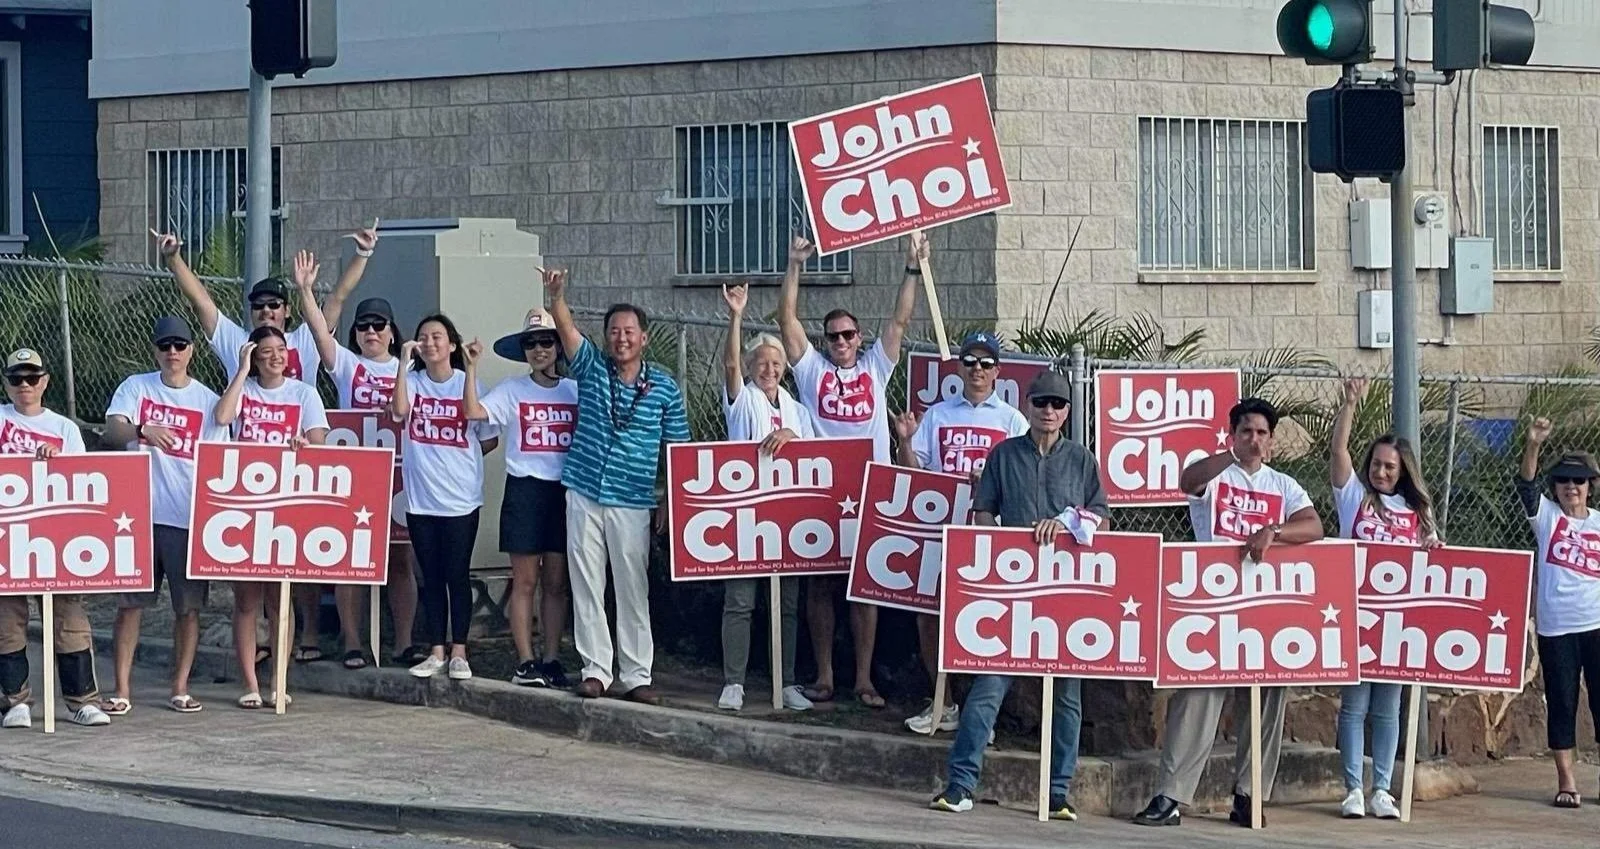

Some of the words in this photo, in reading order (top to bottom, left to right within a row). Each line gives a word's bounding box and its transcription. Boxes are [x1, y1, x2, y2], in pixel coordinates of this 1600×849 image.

[811, 105, 952, 167] John
[822, 137, 992, 232] Choi
[413, 397, 457, 418] John
[917, 361, 1019, 409] Jon
[1107, 378, 1215, 422] John
[411, 418, 465, 443] Choi
[523, 405, 573, 422] John
[525, 426, 572, 447] Cho
[942, 429, 992, 448] John
[943, 450, 986, 472] Cho
[1108, 427, 1229, 491] Ch
[0, 461, 108, 506] ohn
[206, 449, 352, 497] John
[682, 449, 833, 494] John
[875, 473, 973, 525] Joh
[1221, 487, 1268, 514] John
[0, 512, 135, 578] hoi
[203, 506, 373, 568] Choi
[683, 496, 858, 563] Choi
[1220, 510, 1274, 536] Ch
[957, 535, 1116, 586] John
[1166, 551, 1315, 597] John
[1552, 541, 1600, 571] Cho
[955, 595, 1141, 662] Choi
[1166, 603, 1341, 671] Choi
